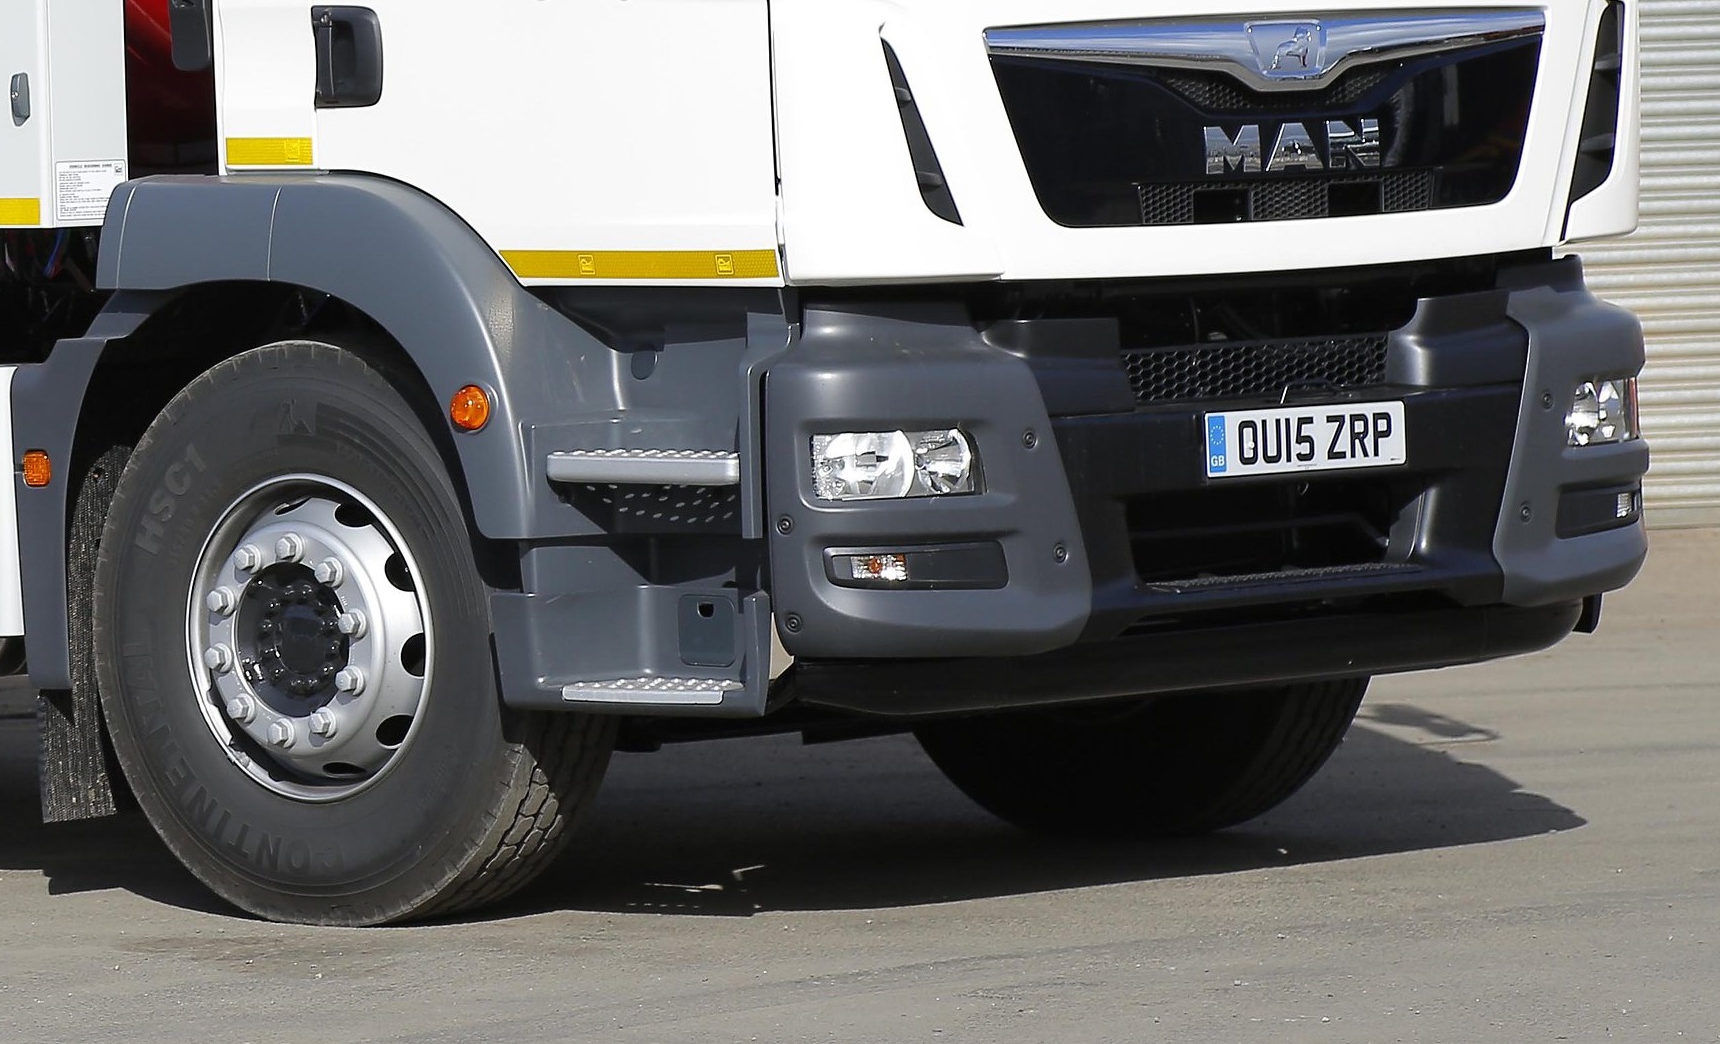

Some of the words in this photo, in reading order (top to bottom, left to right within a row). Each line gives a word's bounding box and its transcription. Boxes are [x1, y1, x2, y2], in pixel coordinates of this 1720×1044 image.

[1203, 119, 1380, 175] MAN
[1211, 454, 1225, 467] GB
[1238, 416, 1315, 465] OU15
[1326, 412, 1392, 460] ZRP
[134, 443, 207, 556] HSC1
